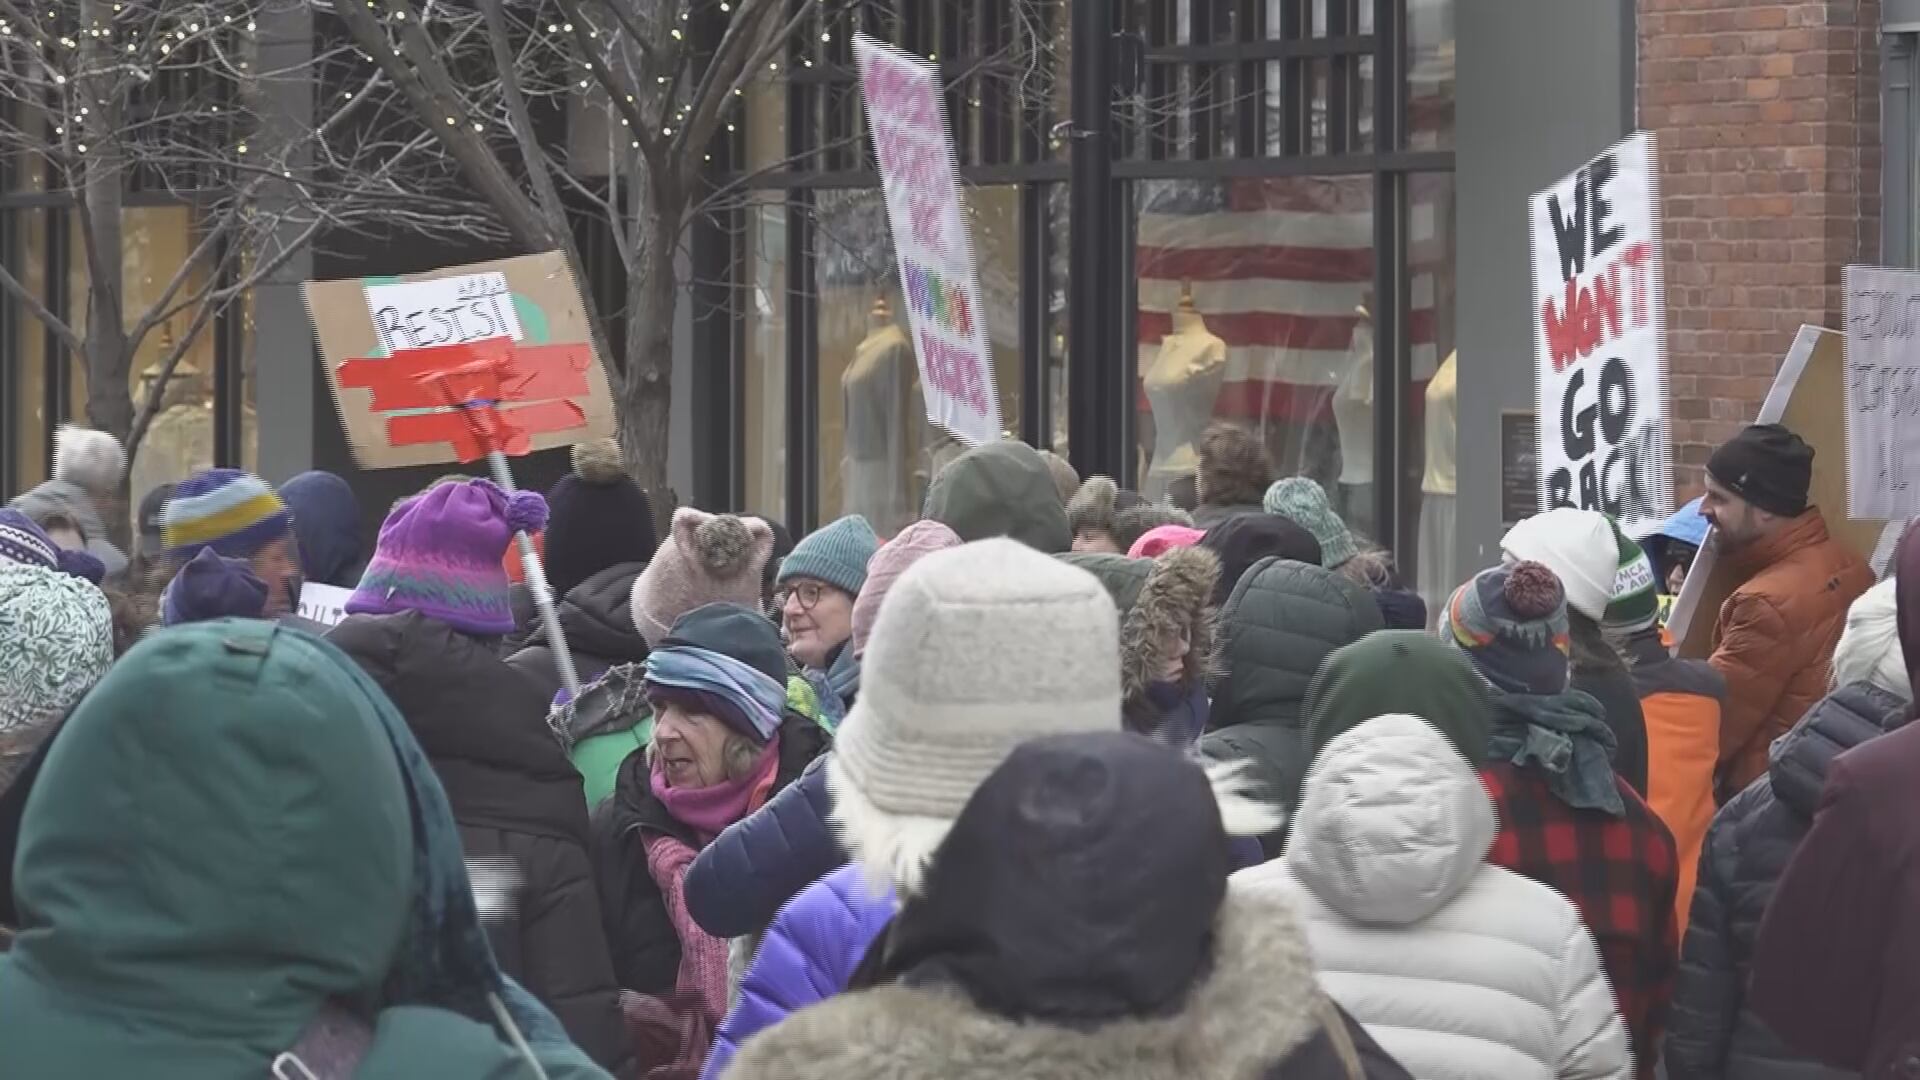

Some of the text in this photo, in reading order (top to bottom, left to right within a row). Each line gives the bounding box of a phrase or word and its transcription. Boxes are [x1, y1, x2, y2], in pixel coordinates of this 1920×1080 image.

[1548, 154, 1625, 282] WE
[376, 292, 508, 351] RESIST
[1561, 357, 1635, 461] GO
[1616, 563, 1645, 582] MCA
